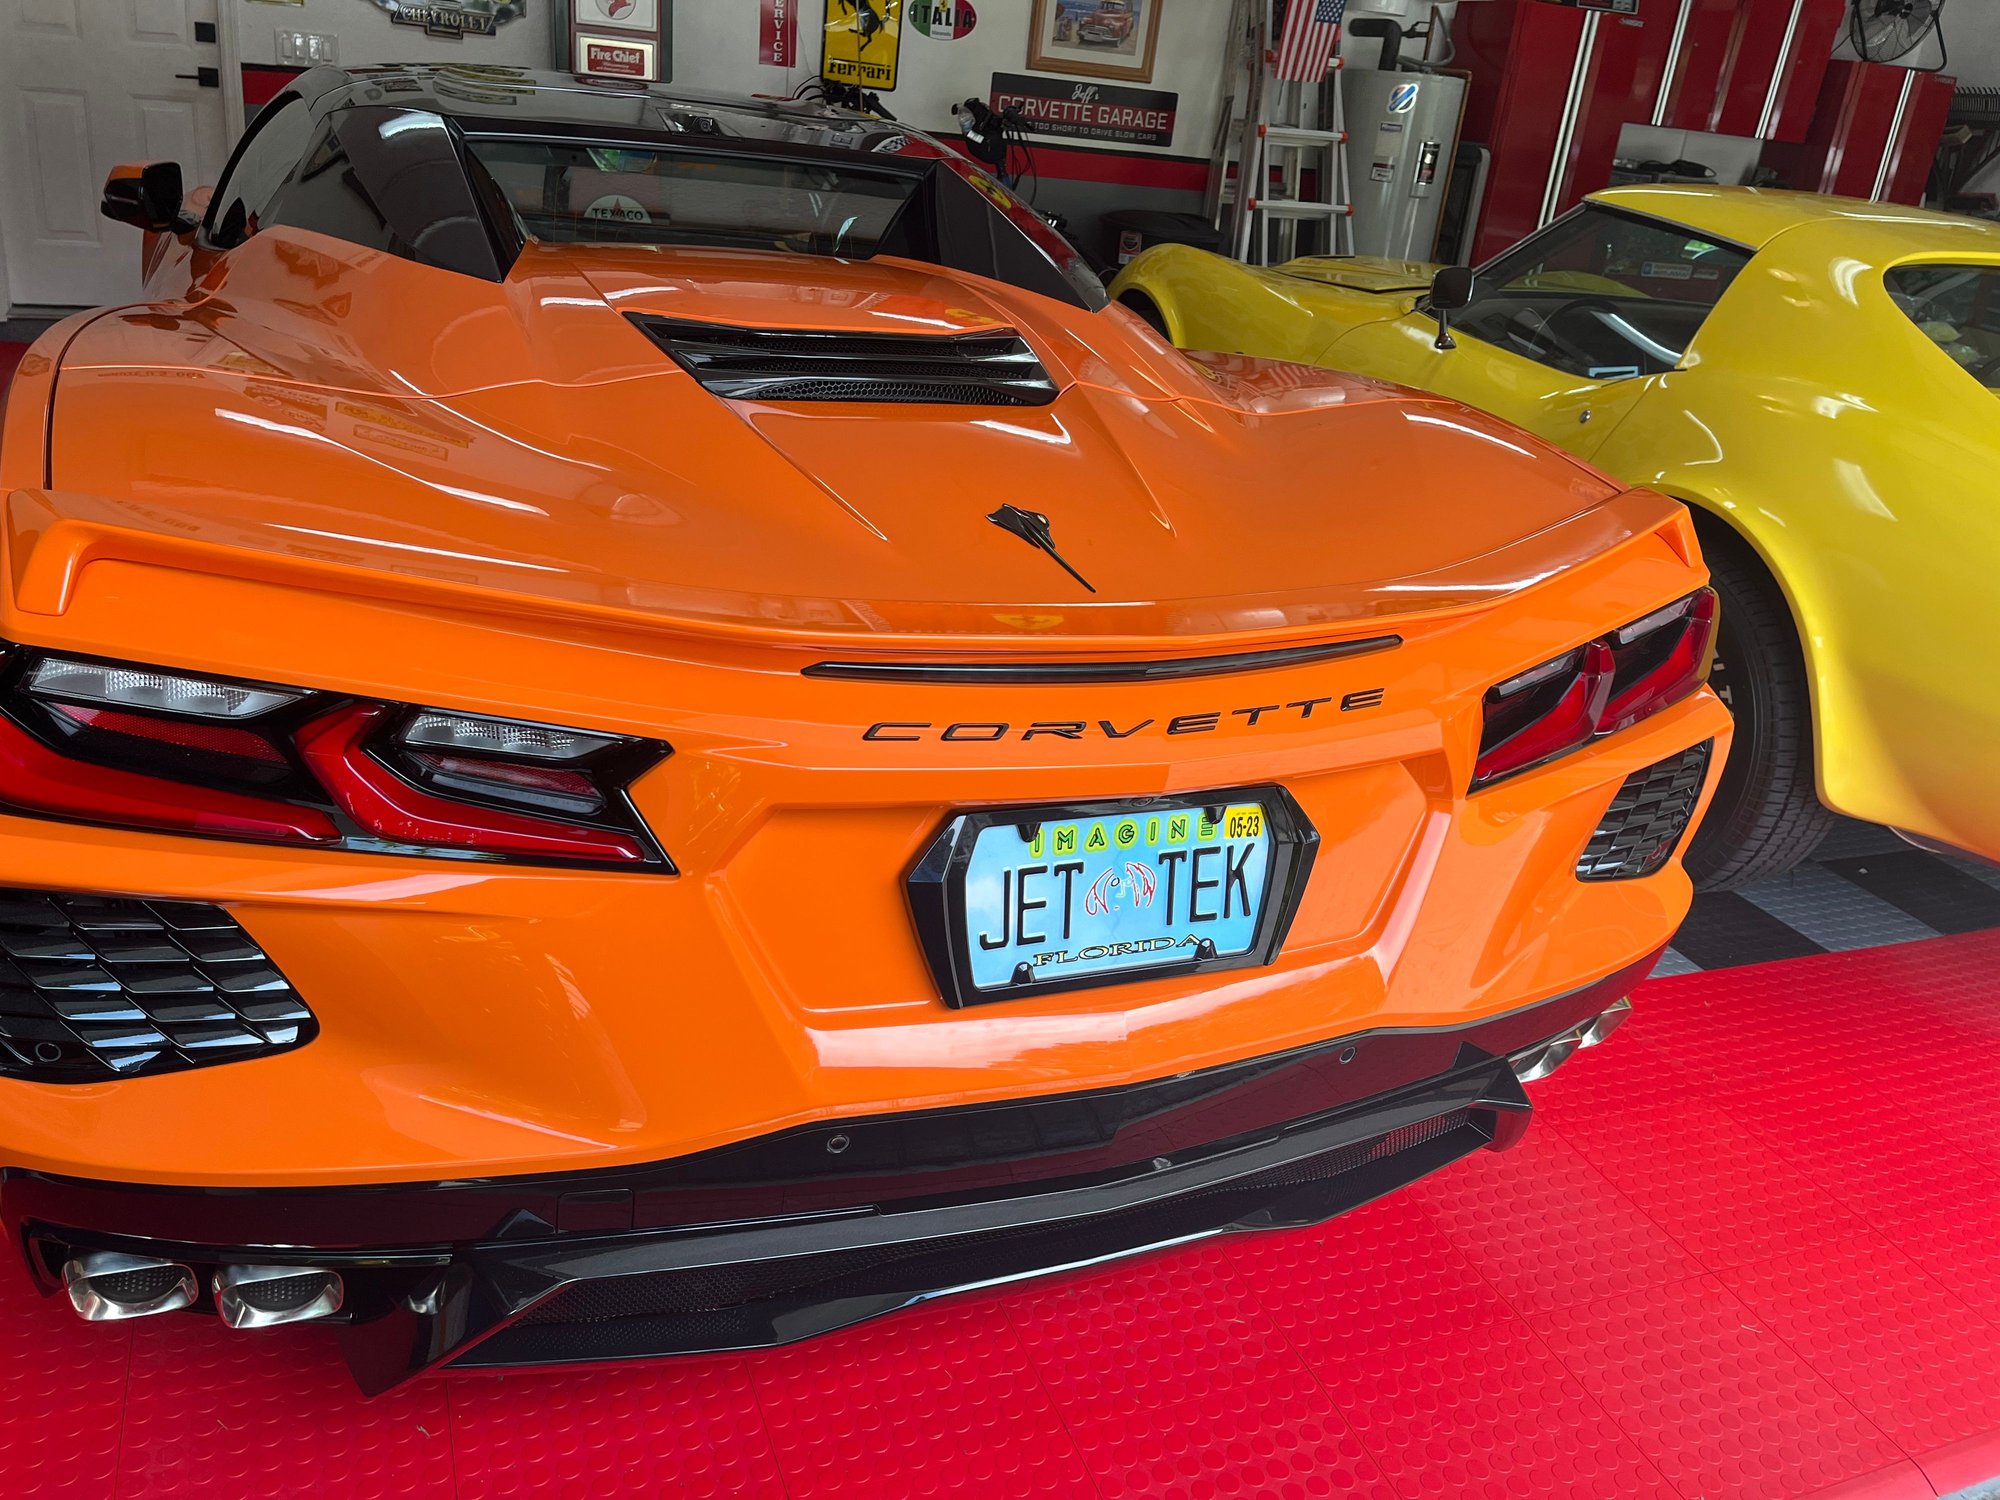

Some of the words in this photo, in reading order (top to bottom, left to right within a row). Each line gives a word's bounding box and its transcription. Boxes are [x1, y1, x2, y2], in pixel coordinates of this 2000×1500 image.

[913, 4, 973, 29] ITALIA
[590, 47, 612, 61] Fire
[612, 50, 640, 64] Chief
[1035, 121, 1049, 130] TOO
[1052, 122, 1077, 133] SHORT
[1080, 126, 1089, 134] TO
[1091, 128, 1112, 137] DRIVE
[1115, 131, 1135, 139] SLOW
[1098, 106, 1169, 130] GARAGE
[592, 207, 644, 221] TEXACO
[862, 687, 1385, 742] CORVETTE
[1032, 815, 1215, 855] IMAGINE
[1229, 815, 1259, 839] 05-23
[978, 860, 1085, 951] JET
[1158, 842, 1255, 926] TEK
[1033, 934, 1202, 968] FLORIDA
